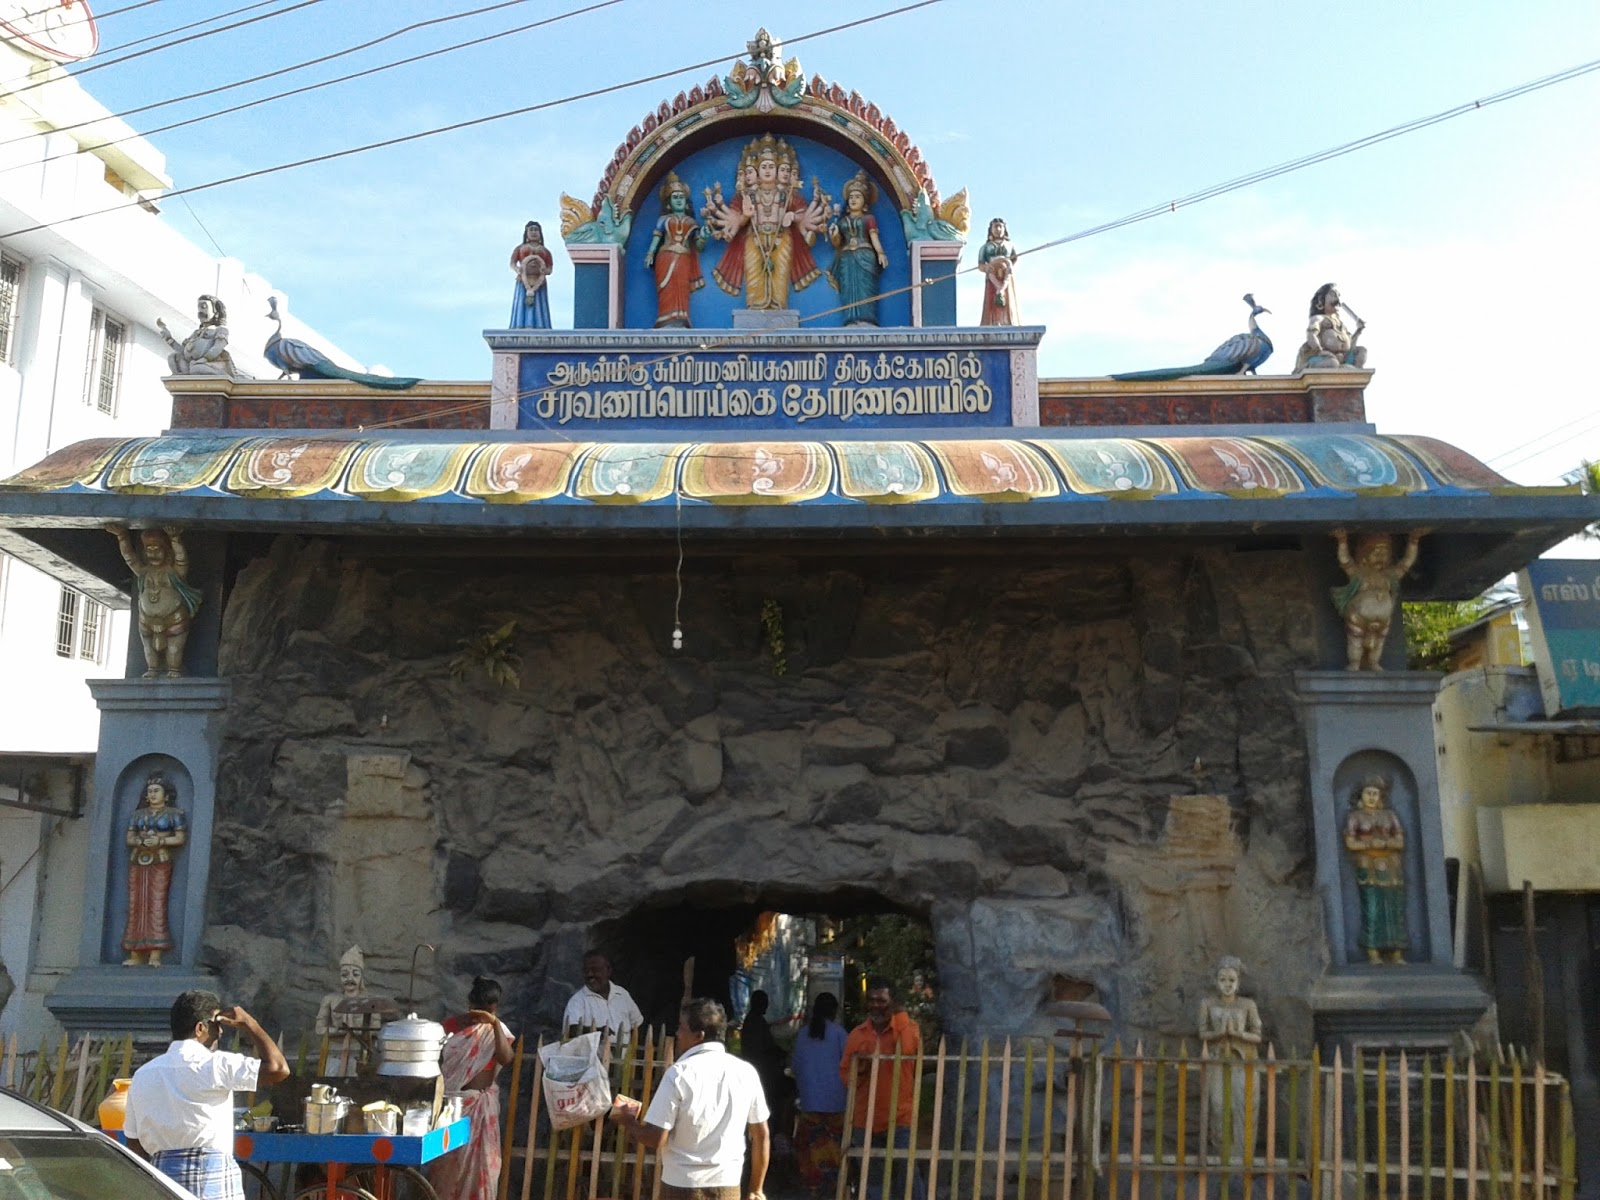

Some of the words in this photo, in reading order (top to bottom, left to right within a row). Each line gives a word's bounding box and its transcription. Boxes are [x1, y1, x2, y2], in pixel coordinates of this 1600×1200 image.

[546, 353, 649, 387] அருள்மிகு
[652, 352, 828, 386] சுப்பிரமணியசுவாமி
[831, 351, 983, 386] திருக்கோவில்
[535, 382, 777, 425] சரவணப்பொய்கை
[781, 378, 993, 423] தோரணவாயில்
